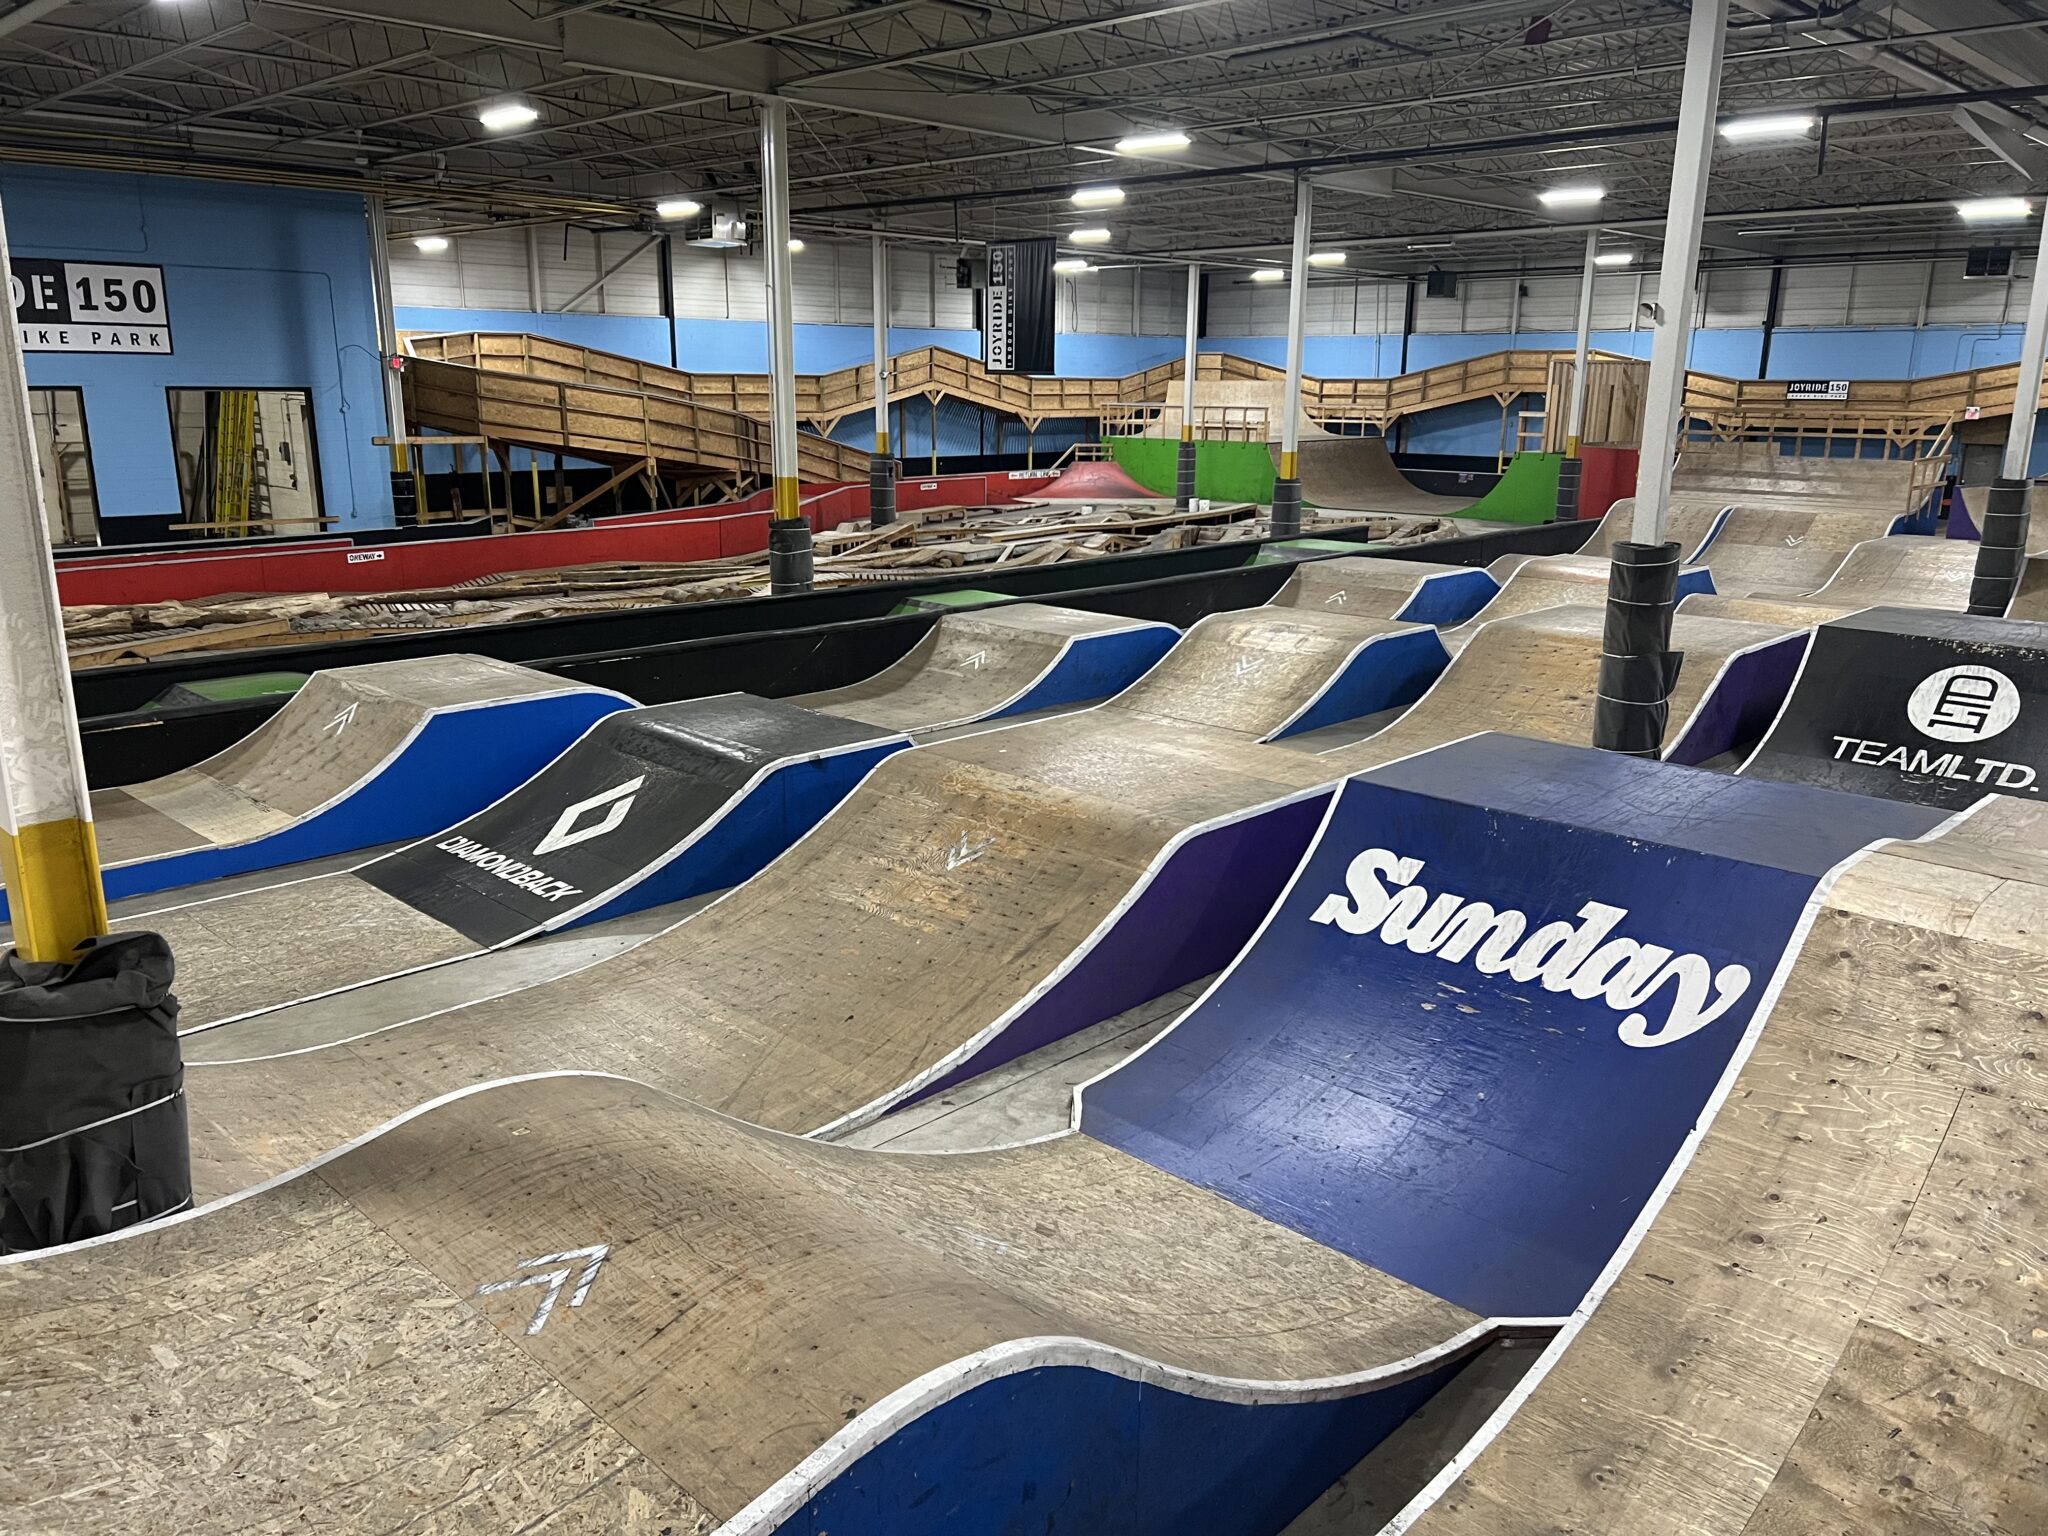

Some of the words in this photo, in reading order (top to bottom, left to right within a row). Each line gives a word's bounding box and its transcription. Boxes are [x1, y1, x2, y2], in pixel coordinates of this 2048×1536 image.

[992, 250, 1004, 284] 150
[75, 276, 157, 313] 150
[91, 331, 161, 347] PARK
[992, 290, 1003, 365] JOYRIDE
[1789, 383, 1828, 392] JOYRIDE
[1830, 383, 1848, 392] 150
[435, 835, 583, 902] DIAMONDBACK
[1309, 847, 1751, 1048] Sunday
